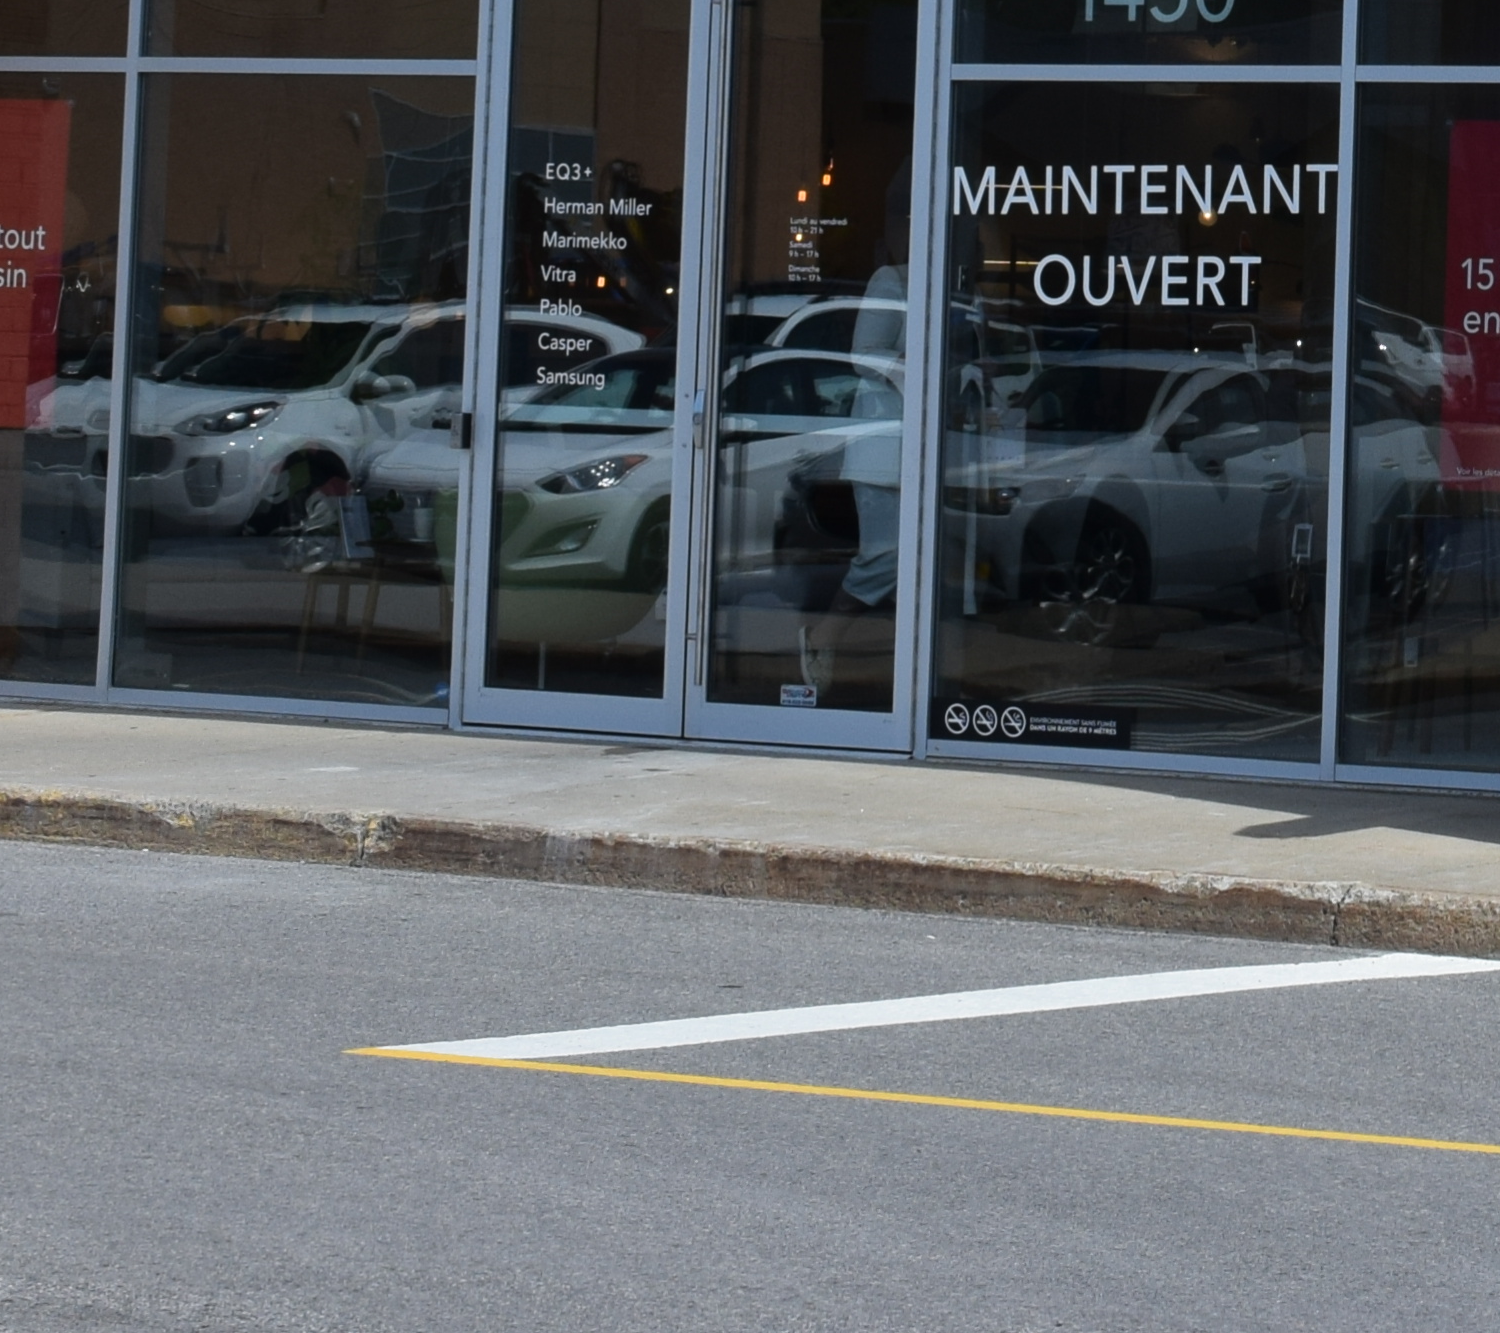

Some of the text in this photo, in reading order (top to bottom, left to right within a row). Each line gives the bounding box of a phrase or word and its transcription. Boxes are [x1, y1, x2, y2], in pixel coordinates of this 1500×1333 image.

[953, 163, 1338, 216] MAINTENANT
[544, 196, 653, 216] Herman Miller
[542, 231, 628, 250] Marimekko
[540, 264, 576, 282] Vitra
[1033, 253, 1261, 307] OUVERT
[540, 298, 582, 317] Pablo
[1463, 311, 1500, 334] en
[538, 332, 593, 356] Casper
[536, 366, 606, 390] Samsung
